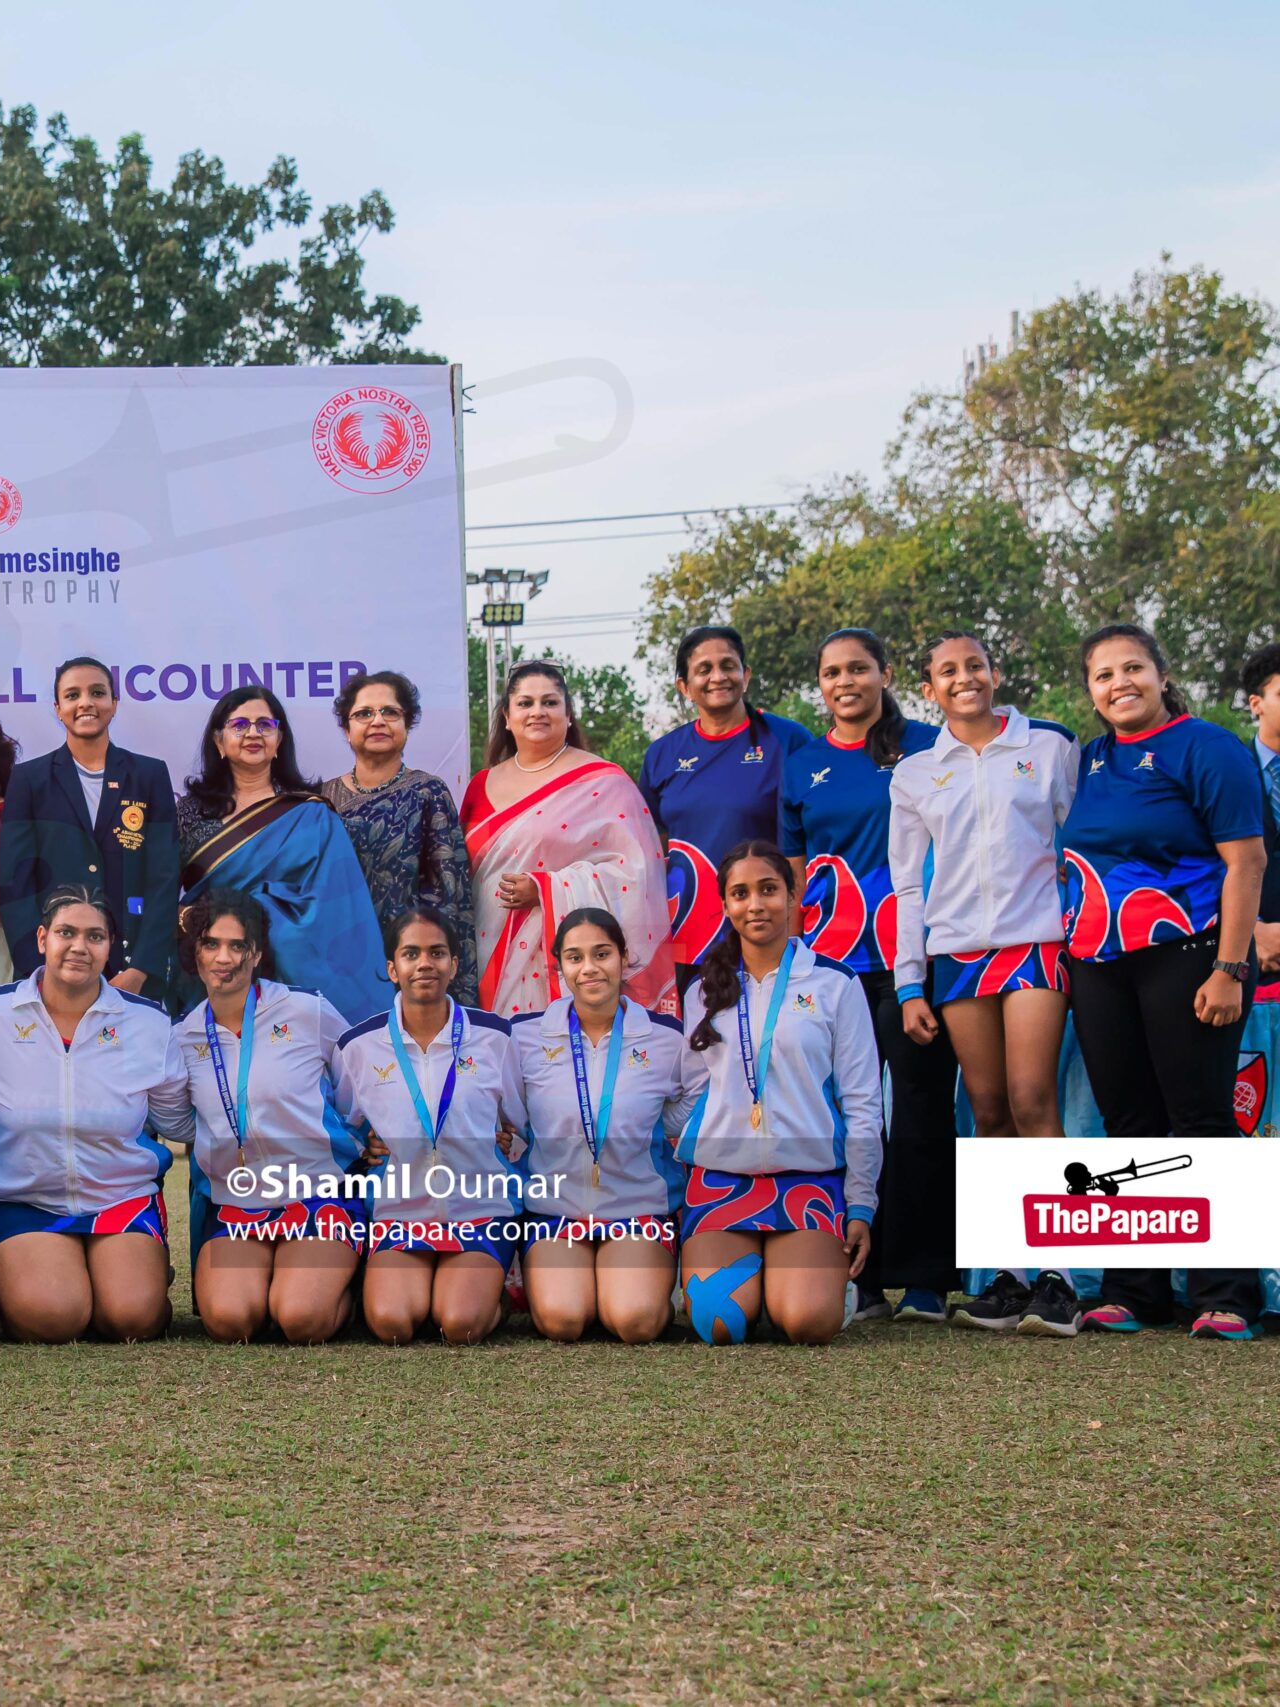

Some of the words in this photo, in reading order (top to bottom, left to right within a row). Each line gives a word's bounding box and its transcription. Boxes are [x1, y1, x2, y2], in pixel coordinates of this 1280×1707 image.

[315, 393, 355, 440] VICTORIA
[358, 389, 411, 414] NOSTRA
[410, 414, 427, 449] FIDES
[316, 442, 341, 477] HAEC
[403, 453, 424, 477] 1900
[2, 579, 121, 605] TROPHY
